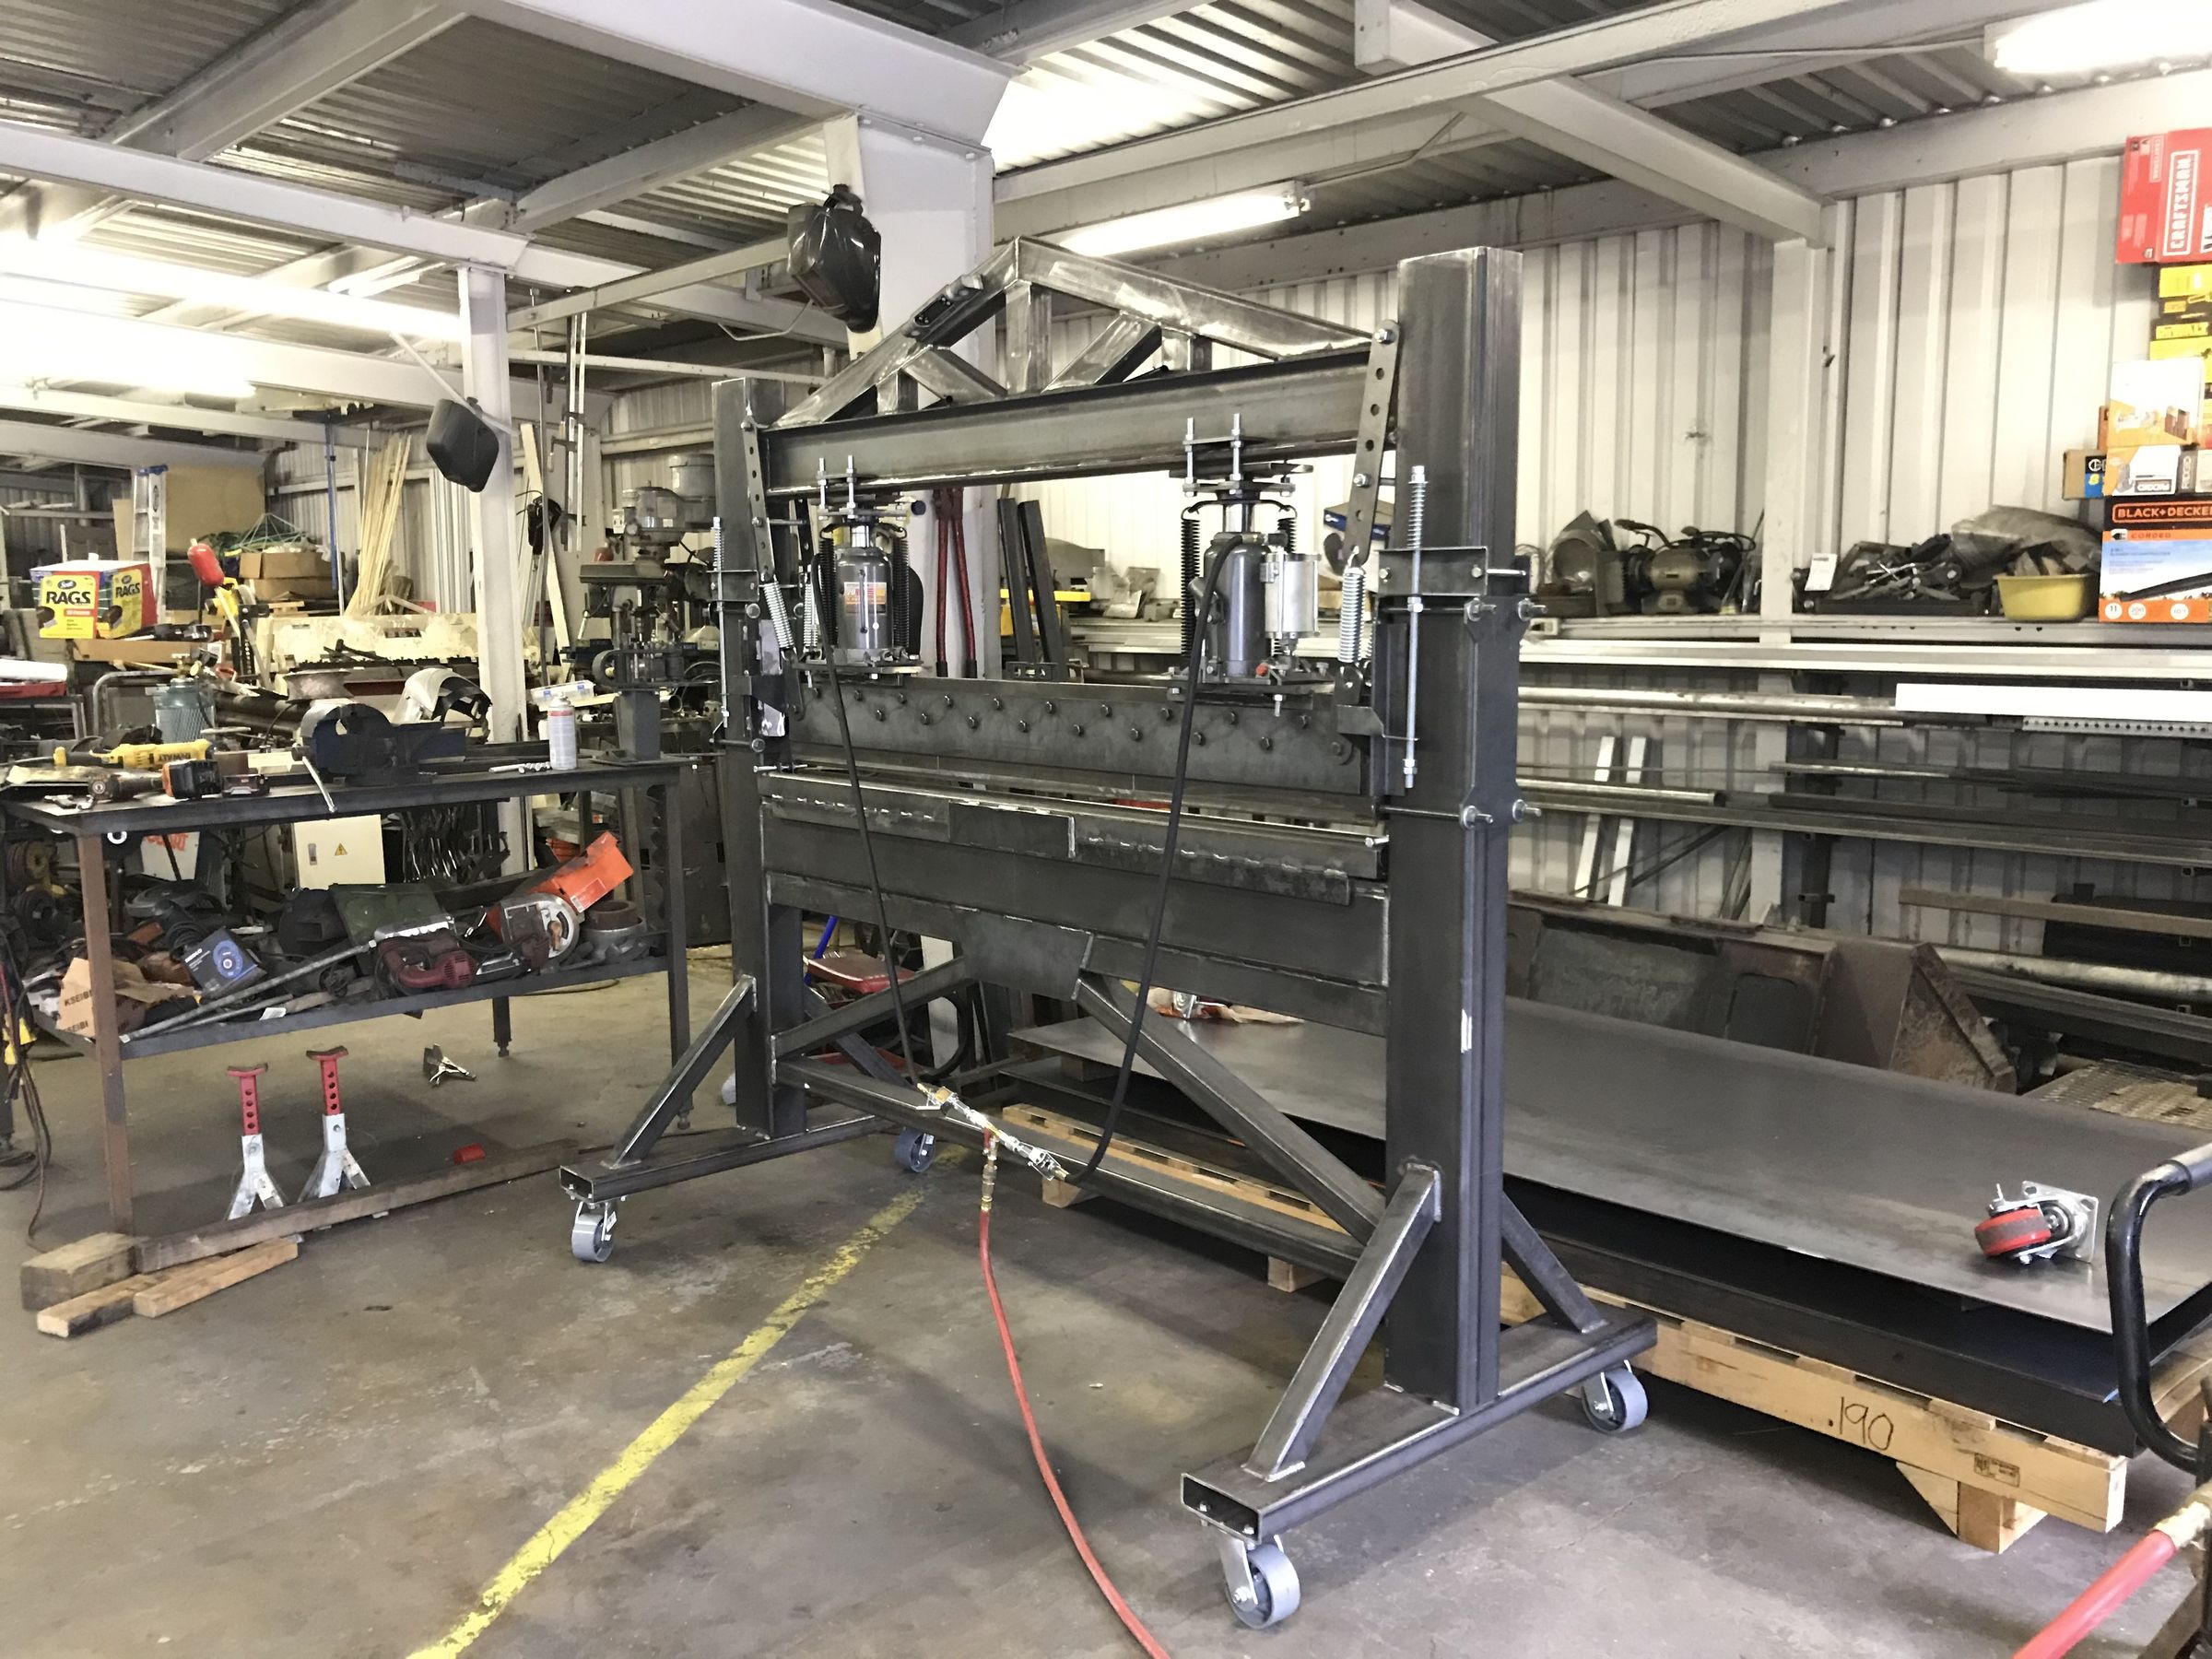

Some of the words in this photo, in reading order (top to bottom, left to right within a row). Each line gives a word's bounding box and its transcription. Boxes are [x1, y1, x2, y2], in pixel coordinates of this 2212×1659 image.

[2170, 157, 2192, 249] CRAFTSMAN
[2117, 506, 2212, 518] BLACK+DECKE
[46, 591, 91, 605] RAGS
[115, 582, 140, 598] RAGS
[1829, 1396, 1894, 1451] .190
